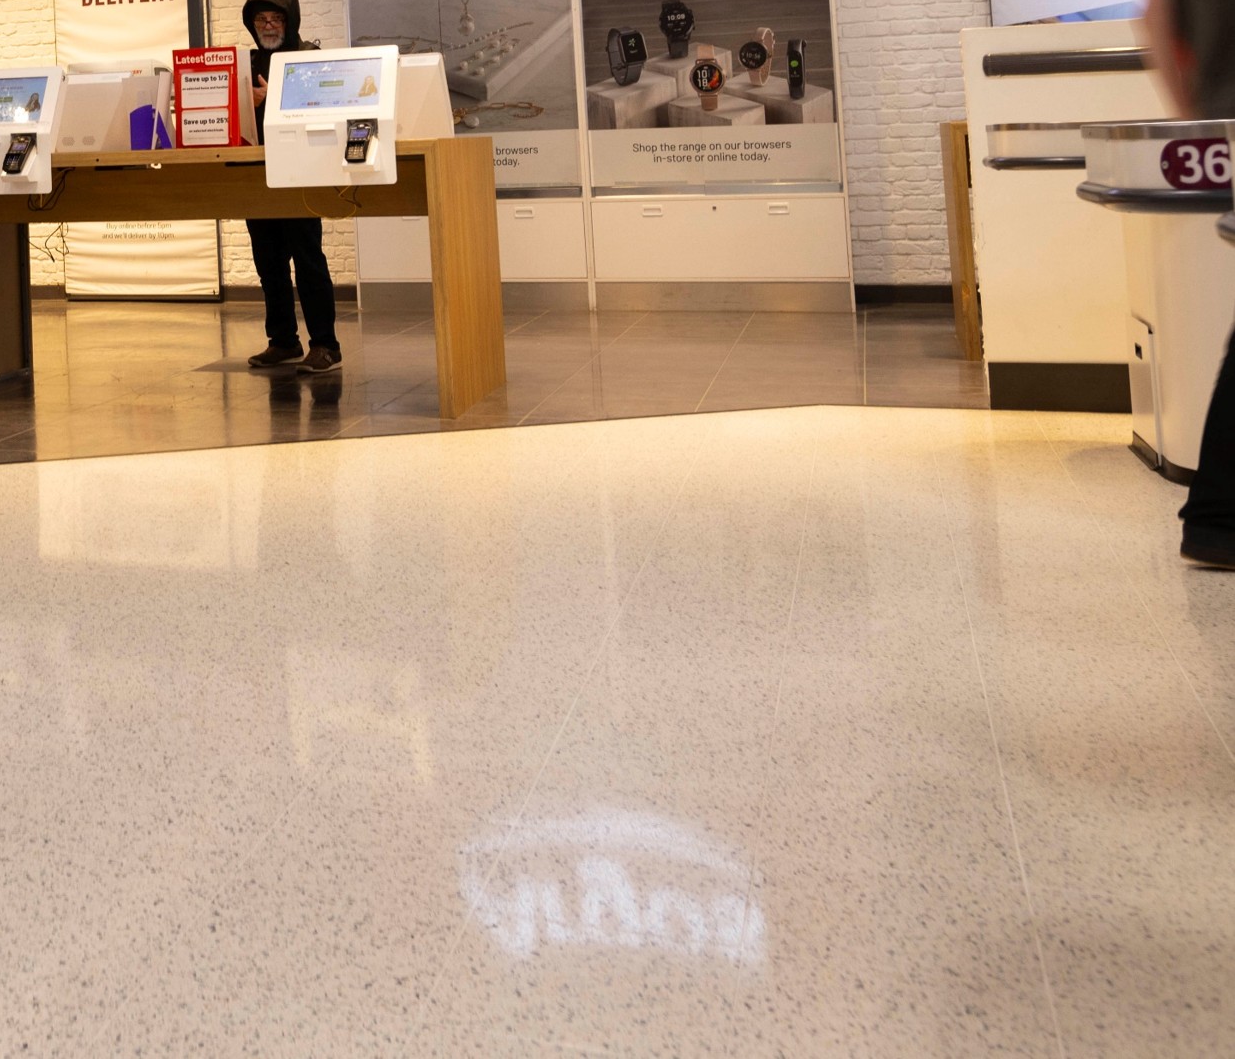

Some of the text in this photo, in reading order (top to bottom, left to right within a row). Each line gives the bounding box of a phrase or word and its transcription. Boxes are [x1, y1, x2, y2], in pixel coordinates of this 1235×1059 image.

[176, 54, 233, 64] Latest offers
[200, 118, 208, 126] up
[496, 146, 538, 155] browsers
[632, 143, 658, 154] Shop
[660, 142, 676, 152] the
[678, 143, 706, 154] range
[724, 142, 741, 150] our
[744, 140, 792, 150] browsers
[653, 152, 770, 163] in-store or online today.
[1176, 143, 1232, 184] 36
[148, 232, 156, 240] by
